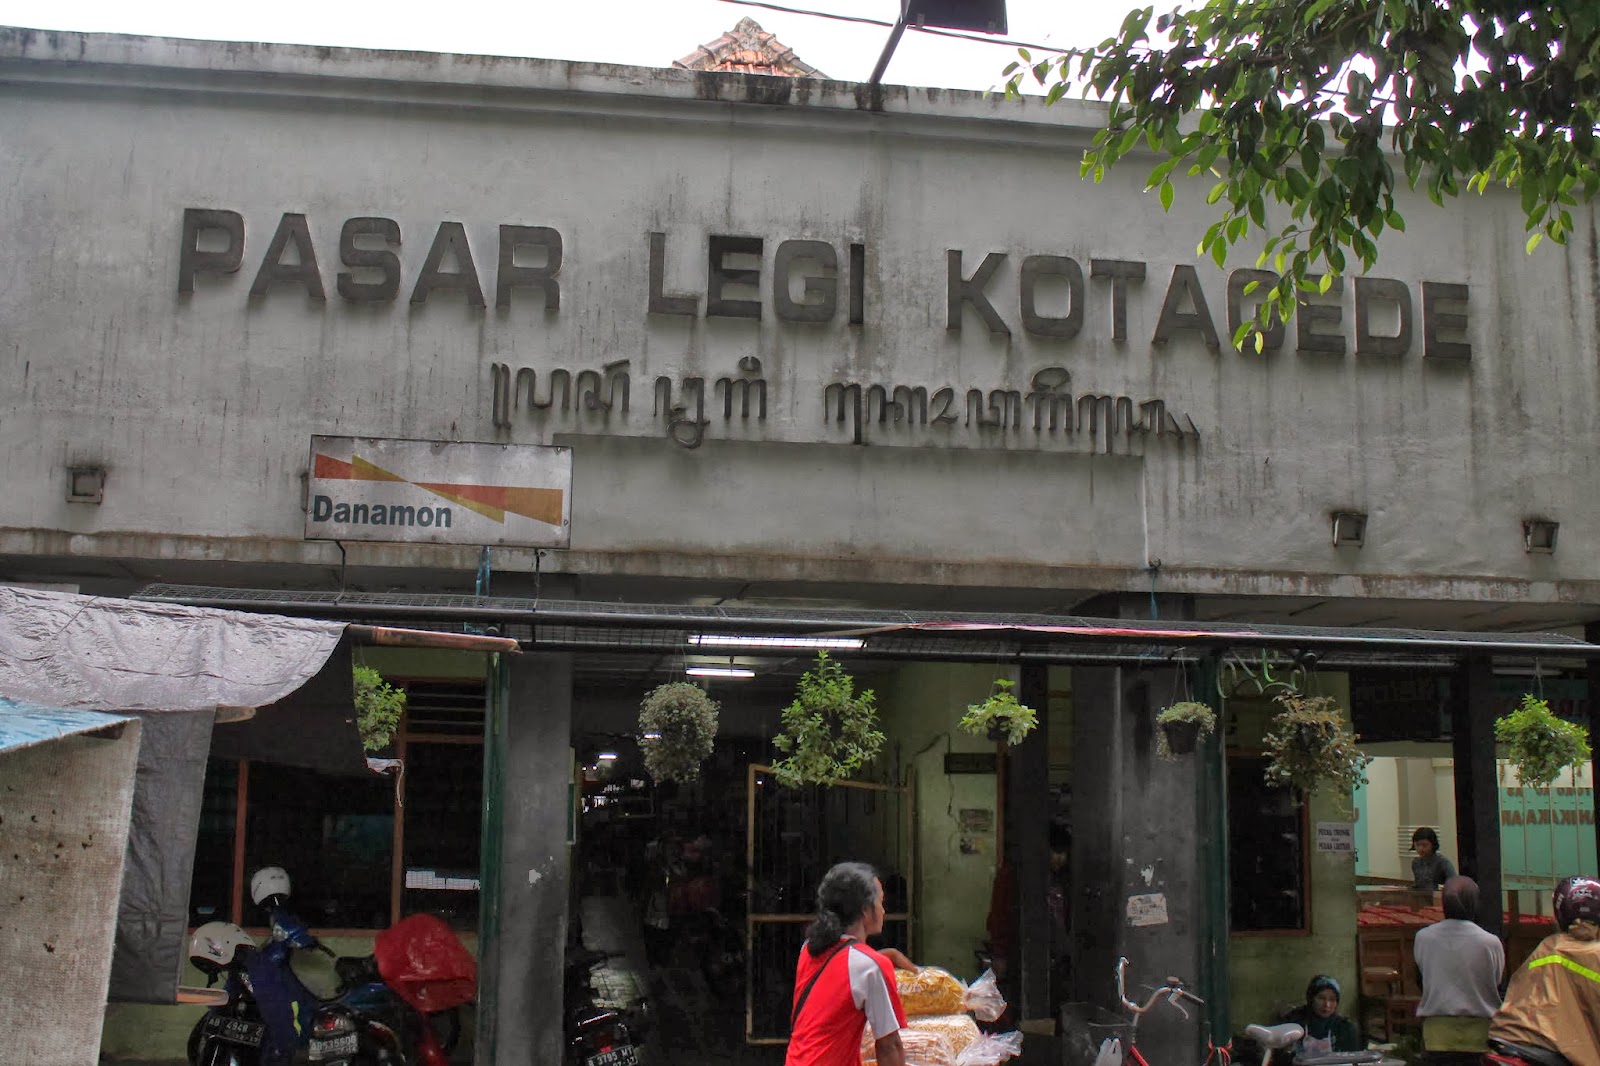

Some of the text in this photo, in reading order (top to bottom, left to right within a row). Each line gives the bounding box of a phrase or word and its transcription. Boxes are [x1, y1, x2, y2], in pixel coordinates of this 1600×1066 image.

[178, 207, 1472, 361] PASAR LEGI KOTAGEDE
[313, 494, 452, 528] Danamon
[597, 1052, 618, 1065] 3795
